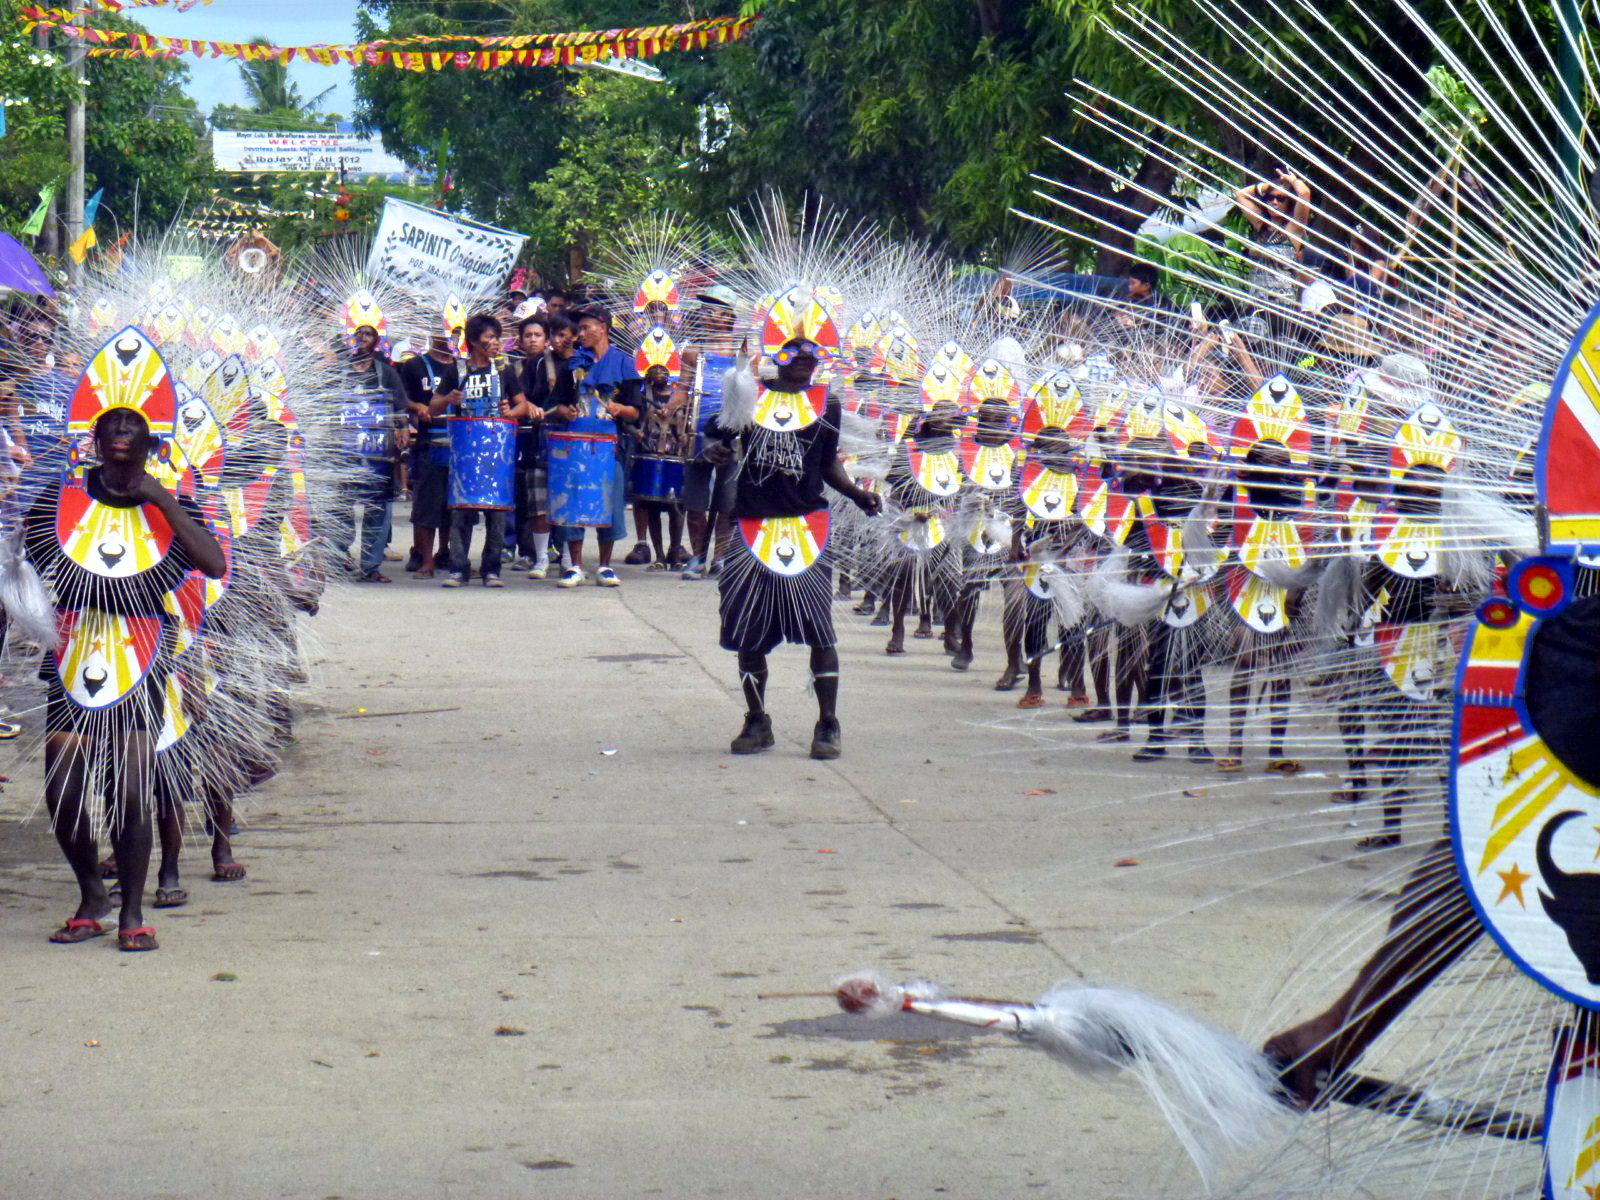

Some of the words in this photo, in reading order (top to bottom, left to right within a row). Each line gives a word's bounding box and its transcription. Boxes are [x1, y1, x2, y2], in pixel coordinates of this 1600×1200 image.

[256, 156, 293, 164] Ibajay
[399, 222, 452, 261] SAPINIT
[448, 244, 500, 277] Original
[427, 264, 453, 280] IBAJAY
